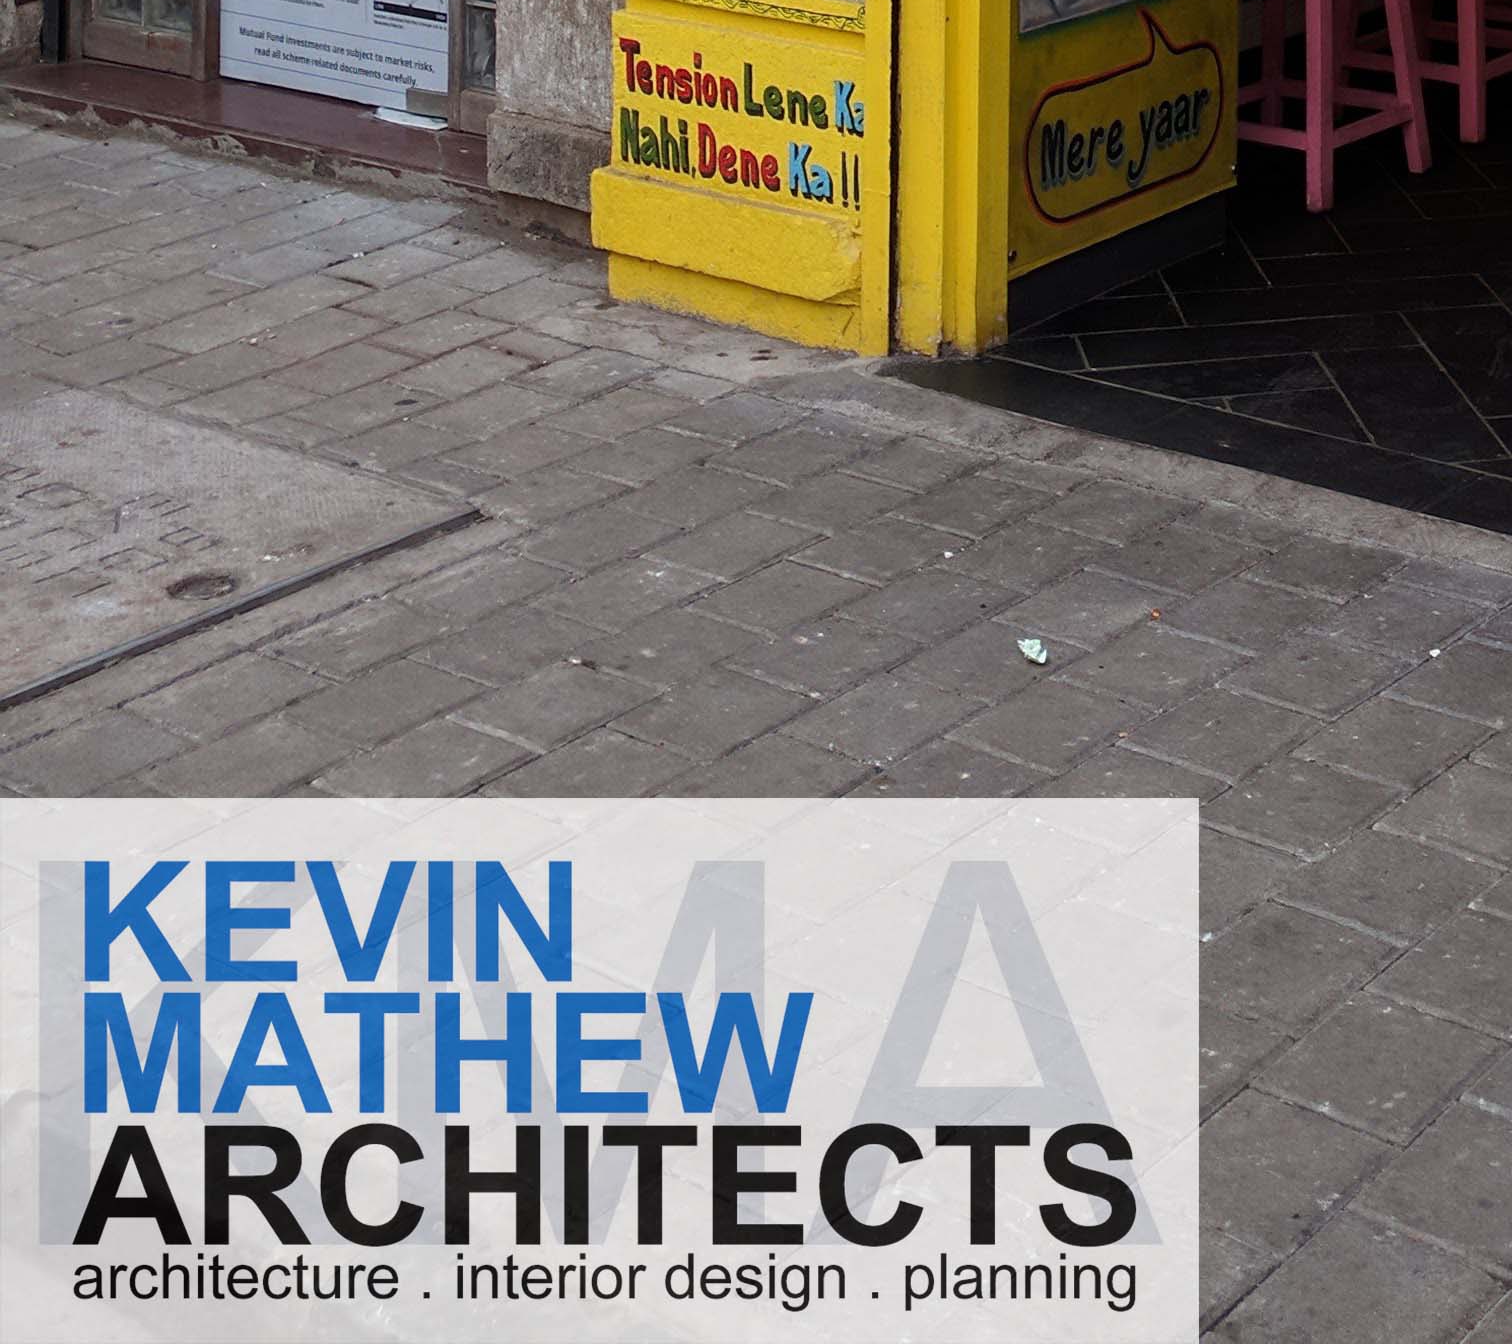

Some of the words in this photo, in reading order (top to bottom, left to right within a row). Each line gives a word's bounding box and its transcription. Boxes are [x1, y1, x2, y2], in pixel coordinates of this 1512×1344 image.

[239, 26, 264, 39] Mutual
[266, 31, 284, 43] Fund
[286, 35, 330, 53] investments
[332, 45, 345, 55] are
[346, 46, 373, 61] subject
[375, 52, 384, 62] to
[385, 55, 412, 68] market
[254, 46, 269, 57] read
[270, 50, 281, 59] all
[340, 62, 381, 79] documents
[619, 37, 739, 113] Tension
[743, 62, 829, 130] Lene
[834, 80, 864, 138] Ka
[619, 107, 696, 178] Nahi,
[697, 123, 780, 192] Dene
[789, 142, 834, 205] Ka
[1040, 118, 1125, 191] Mere
[1126, 88, 1211, 187] yaar
